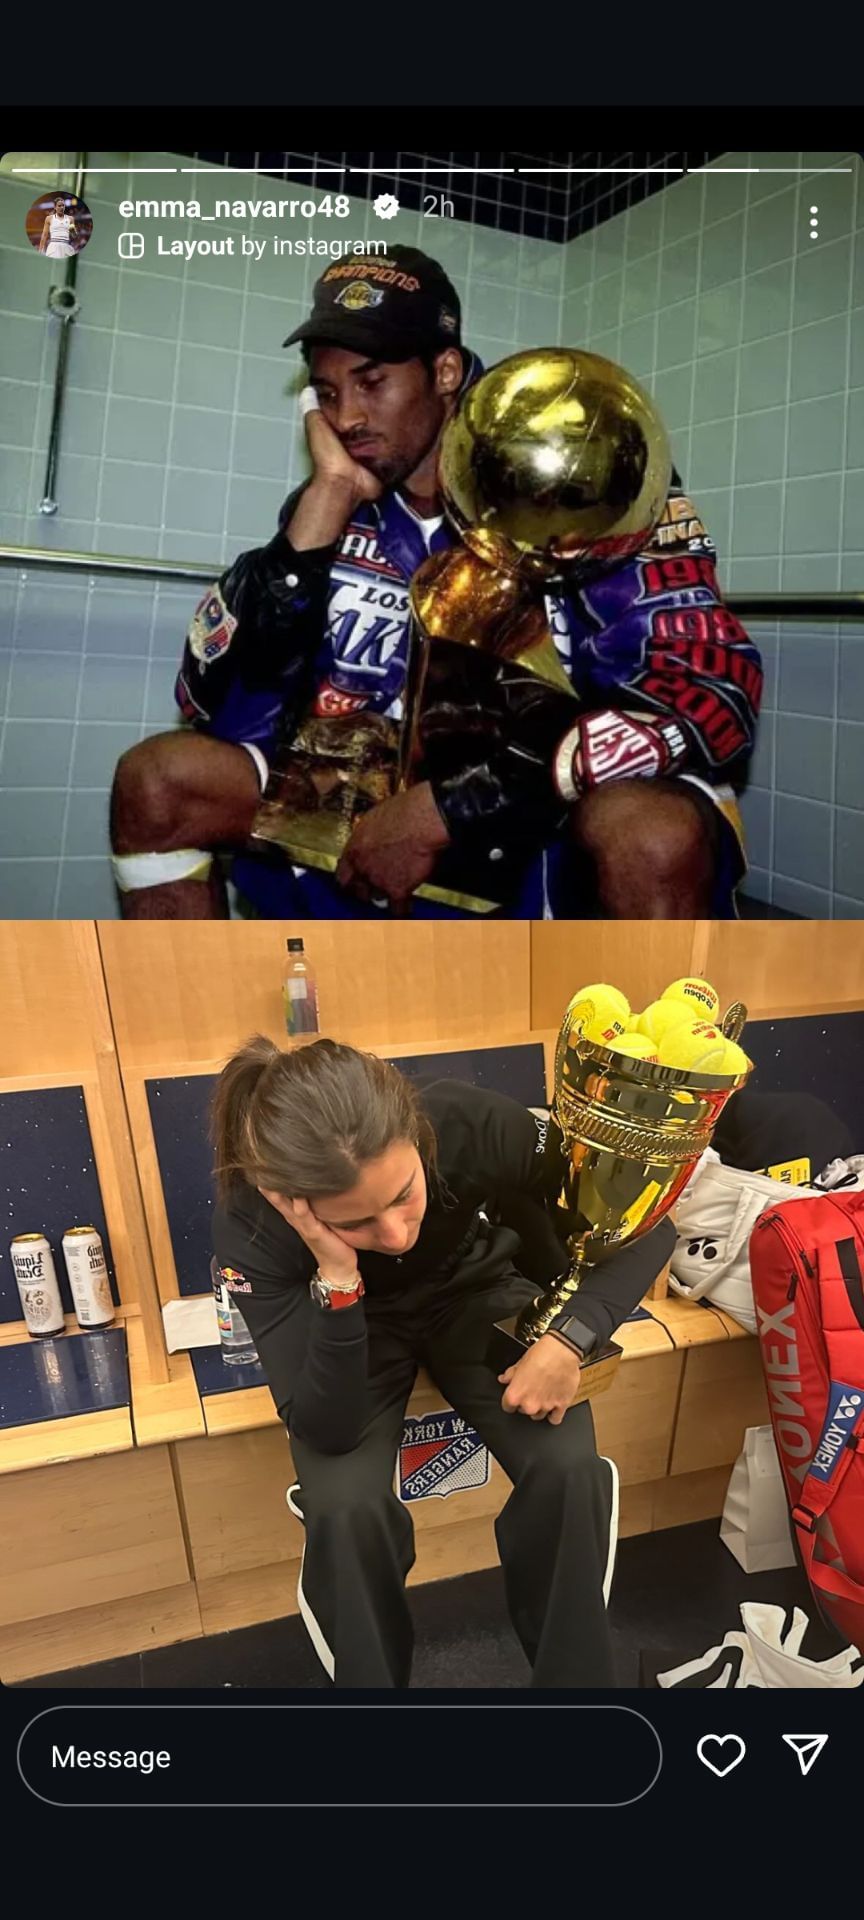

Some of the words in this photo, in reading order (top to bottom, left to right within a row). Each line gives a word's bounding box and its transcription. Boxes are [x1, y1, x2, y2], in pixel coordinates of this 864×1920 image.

[360, 586, 410, 612] LOS
[586, 709, 659, 784] WEST
[662, 723, 688, 758] NBA
